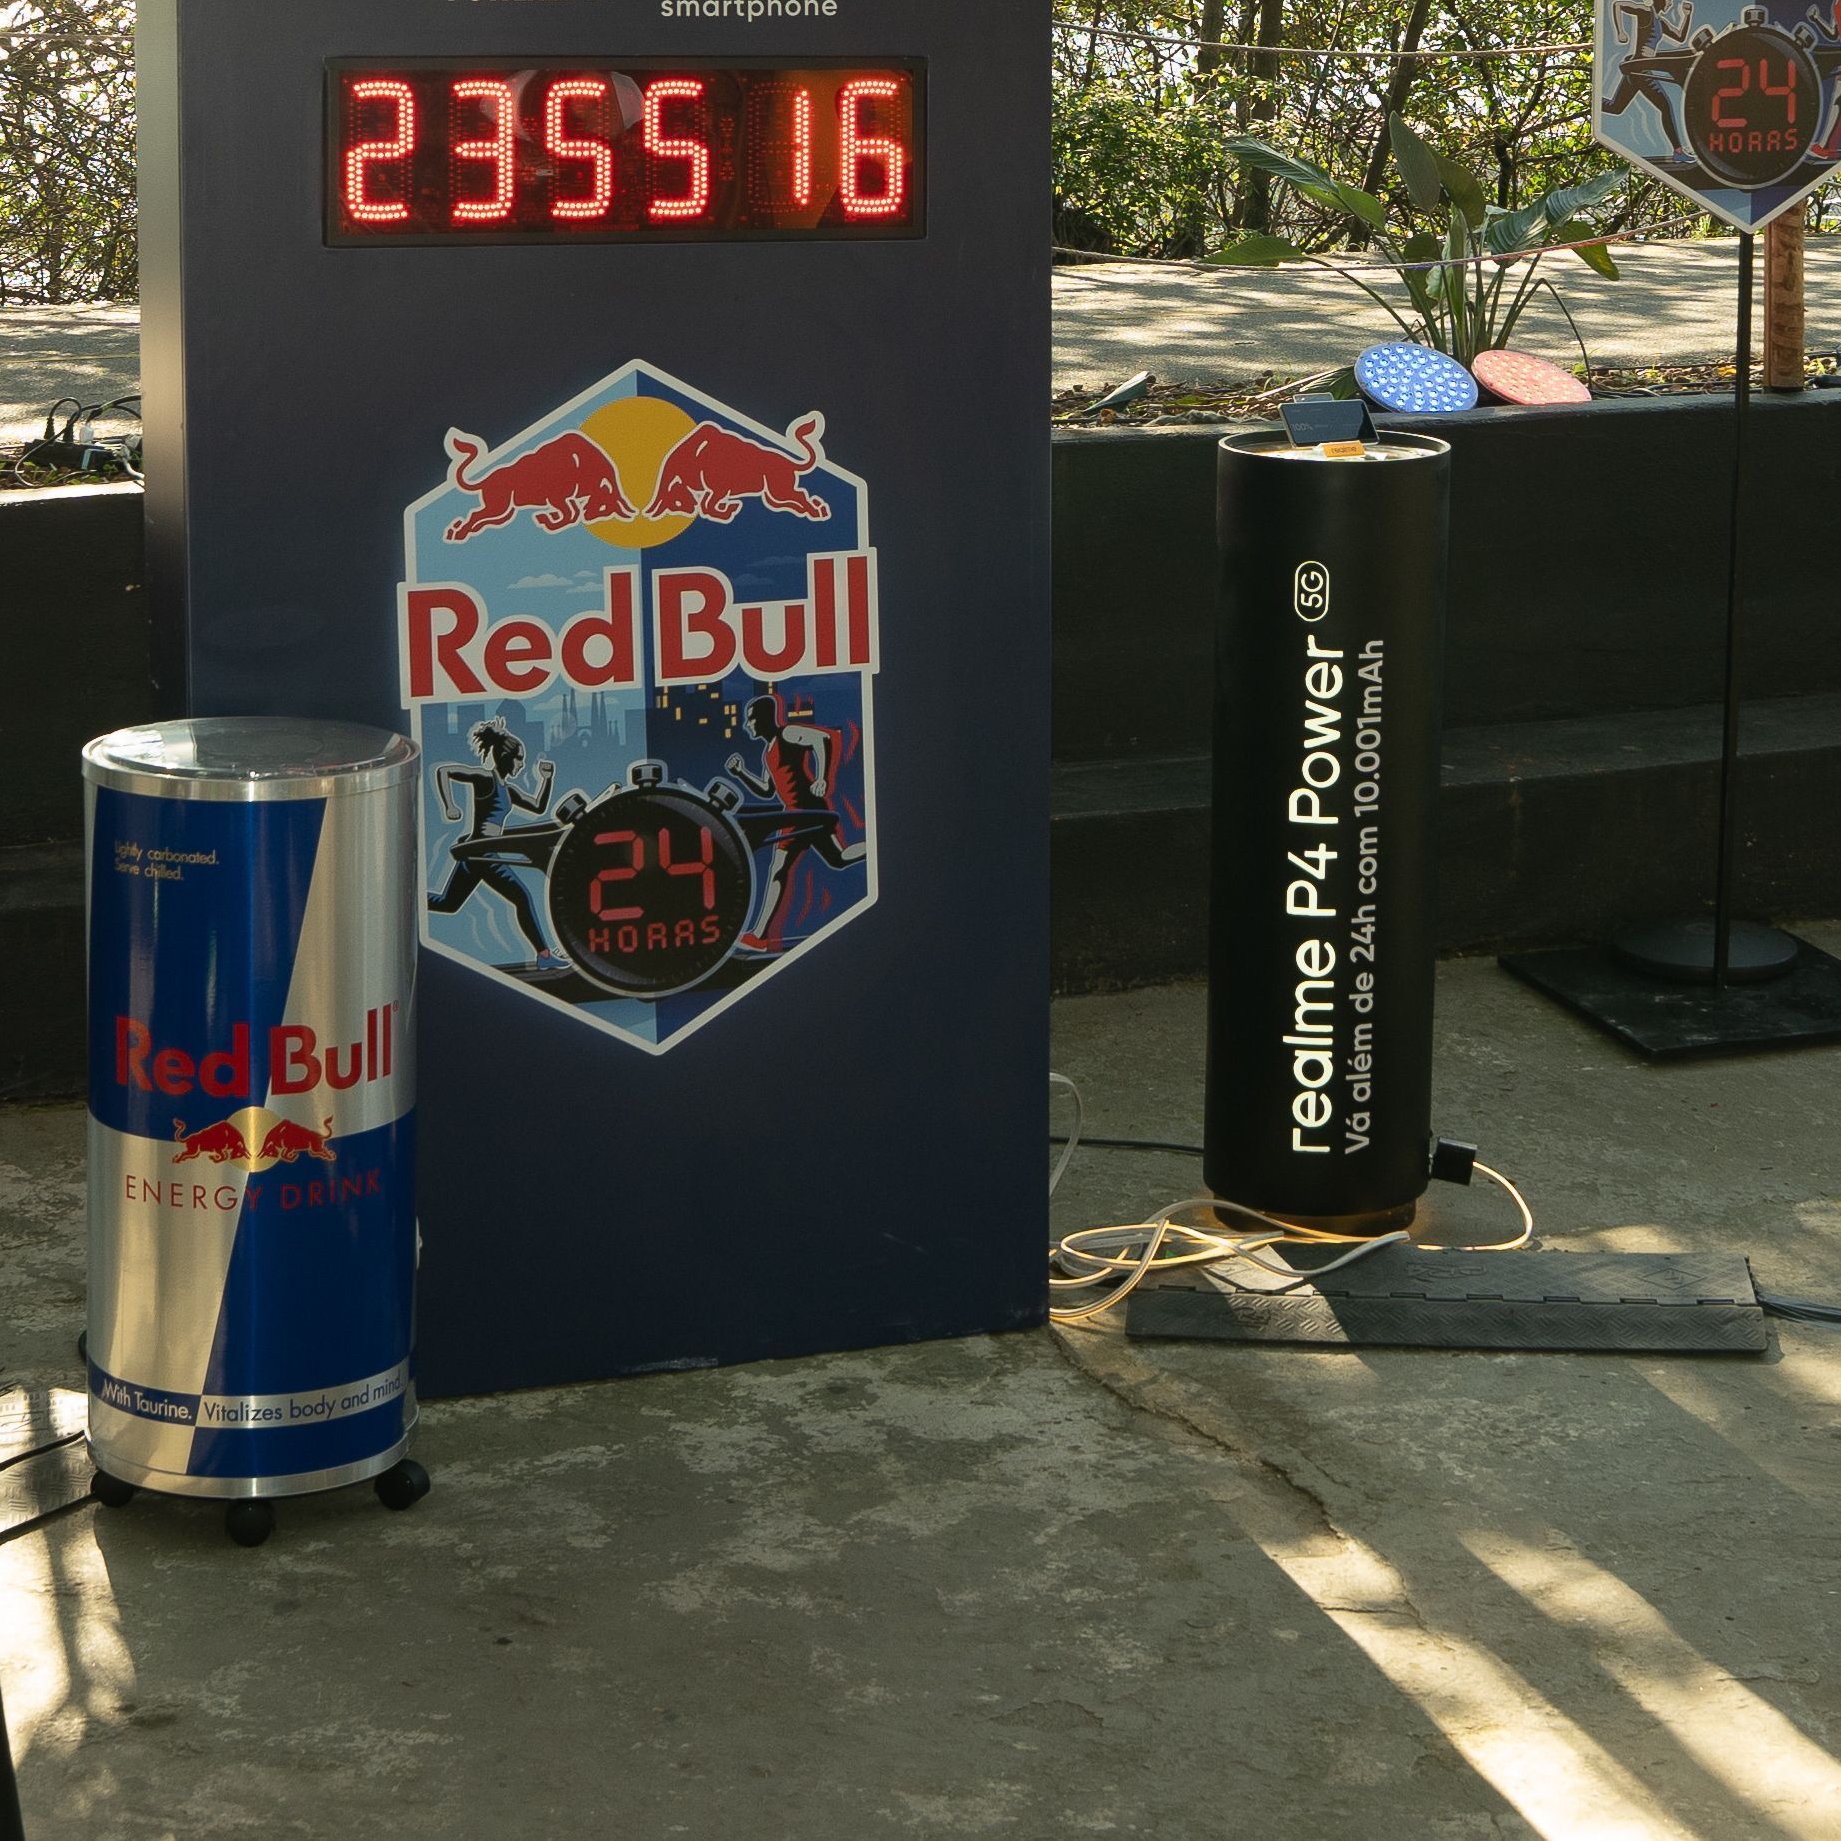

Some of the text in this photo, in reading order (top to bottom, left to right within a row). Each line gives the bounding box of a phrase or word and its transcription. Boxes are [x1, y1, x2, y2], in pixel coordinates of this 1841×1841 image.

[1711, 58, 1796, 128] 24
[1709, 129, 1798, 154] HORAS
[406, 556, 870, 698] Red Bull
[589, 826, 715, 920] 24
[1283, 571, 1344, 1153] realme P4 Power 5G
[1345, 639, 1384, 1155] Vá além de 24h com 10.001mAh
[588, 915, 720, 955] HORAS
[116, 1003, 391, 1098] Red Bull
[125, 1168, 381, 1210] ENERGY DRINK
[101, 1371, 404, 1422] With Taurine. Vitalizes body and mind.
